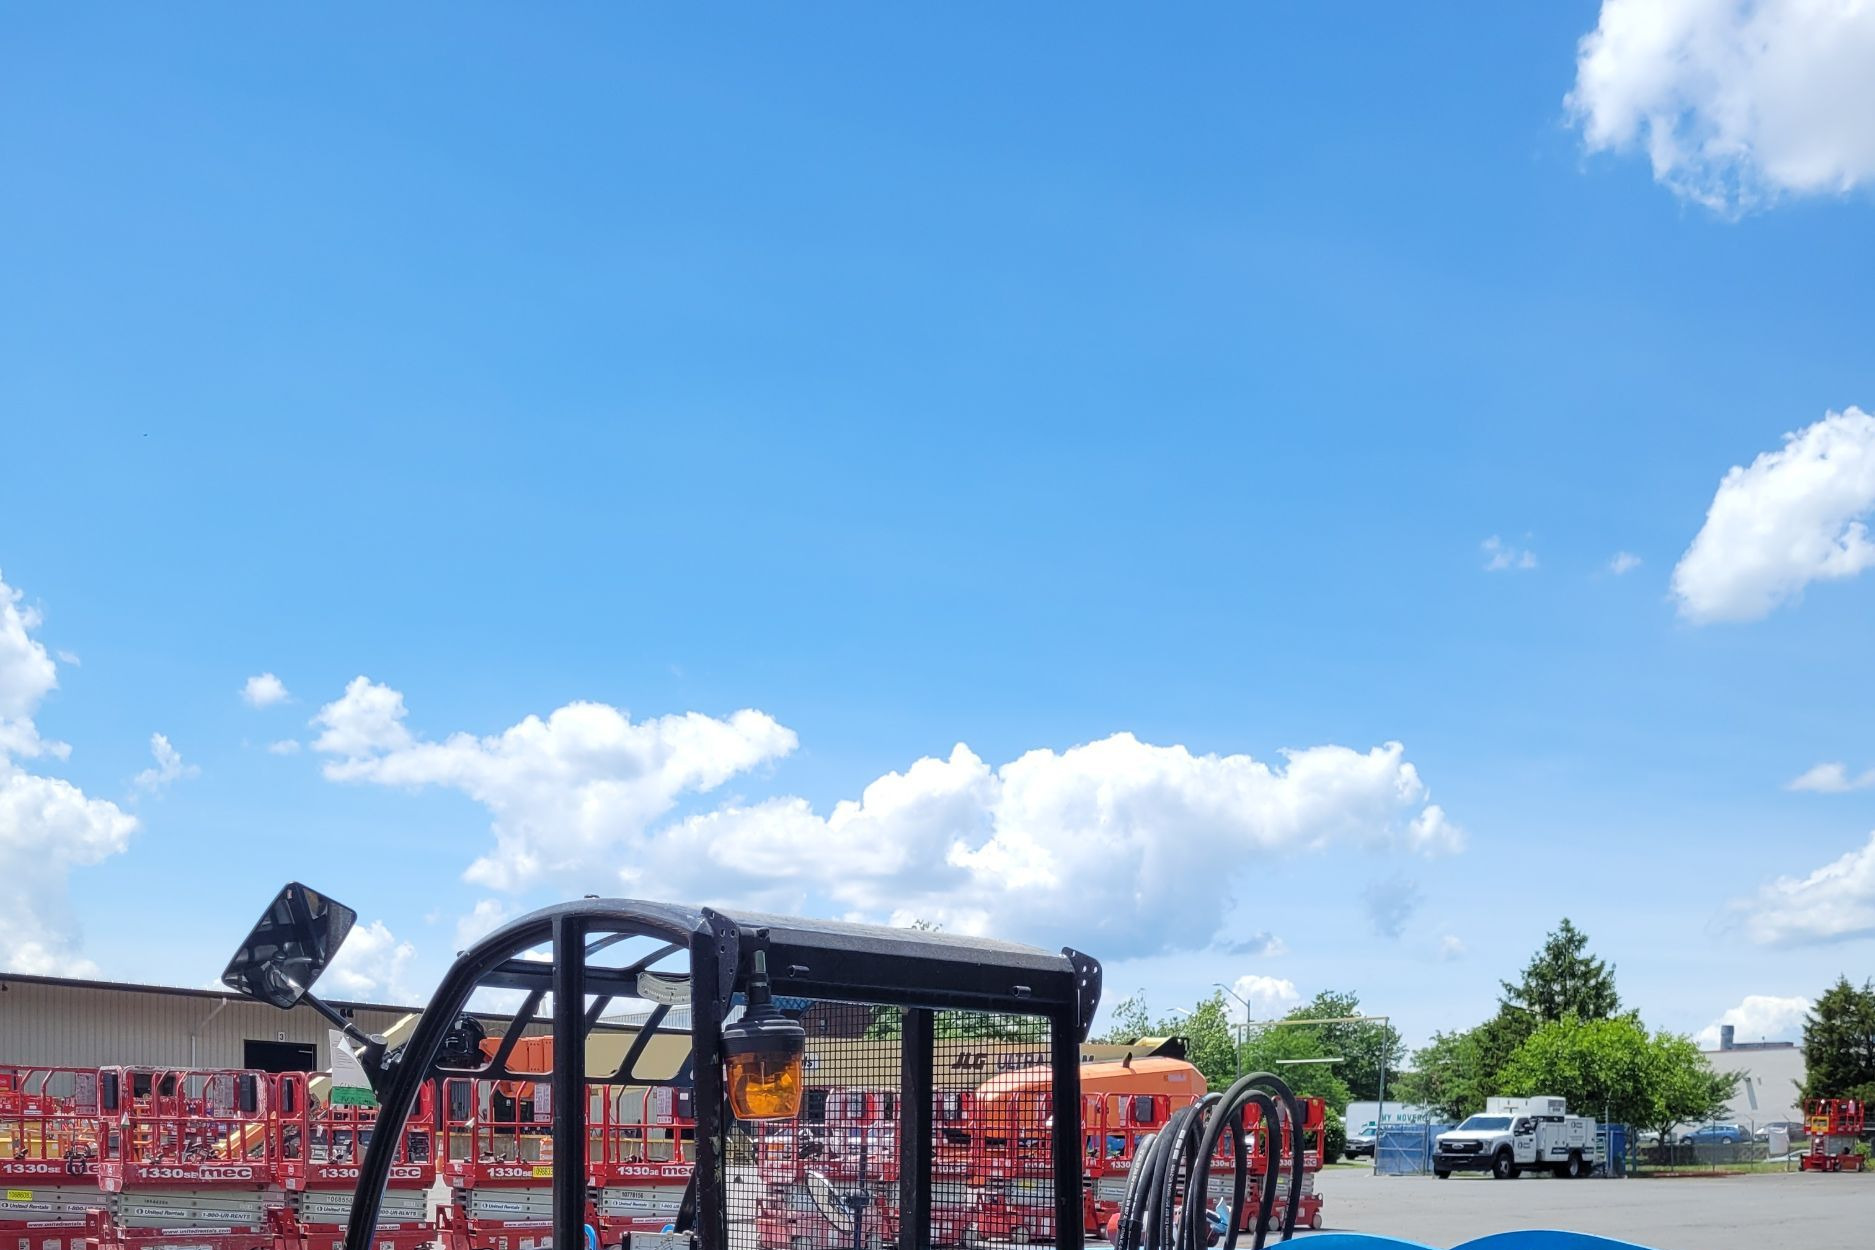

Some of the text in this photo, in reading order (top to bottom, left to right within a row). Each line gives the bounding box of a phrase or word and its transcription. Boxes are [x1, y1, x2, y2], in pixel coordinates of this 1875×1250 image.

[951, 1052, 988, 1070] JLG
[138, 1167, 199, 1179] 1330SE
[200, 1167, 251, 1178] mec
